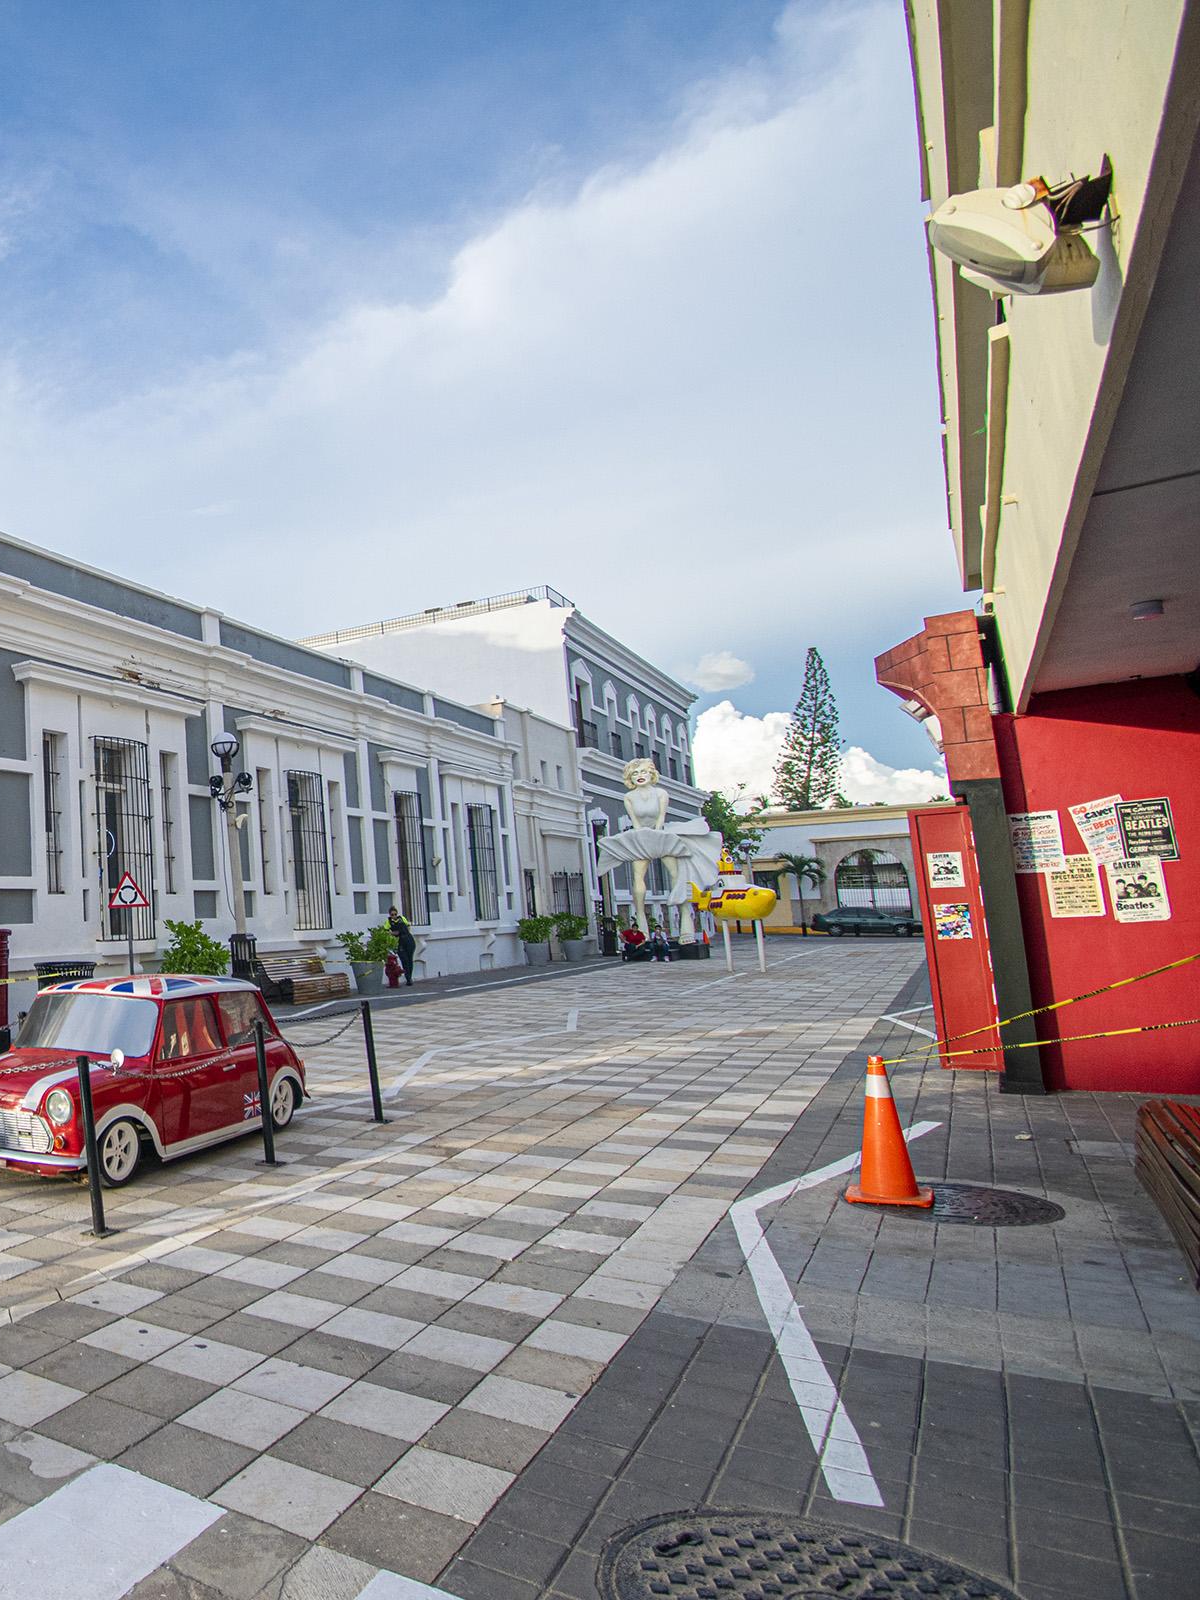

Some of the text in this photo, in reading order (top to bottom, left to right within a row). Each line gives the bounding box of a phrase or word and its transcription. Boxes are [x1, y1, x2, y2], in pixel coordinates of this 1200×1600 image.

[1132, 805, 1162, 813] CAVERN
[1093, 817, 1117, 831] BEAT
[1125, 817, 1169, 831] BEATLES
[1113, 860, 1142, 870] CAVERN
[1050, 872, 1095, 881] SPECTACULAR
[1116, 901, 1155, 912] Beatles
